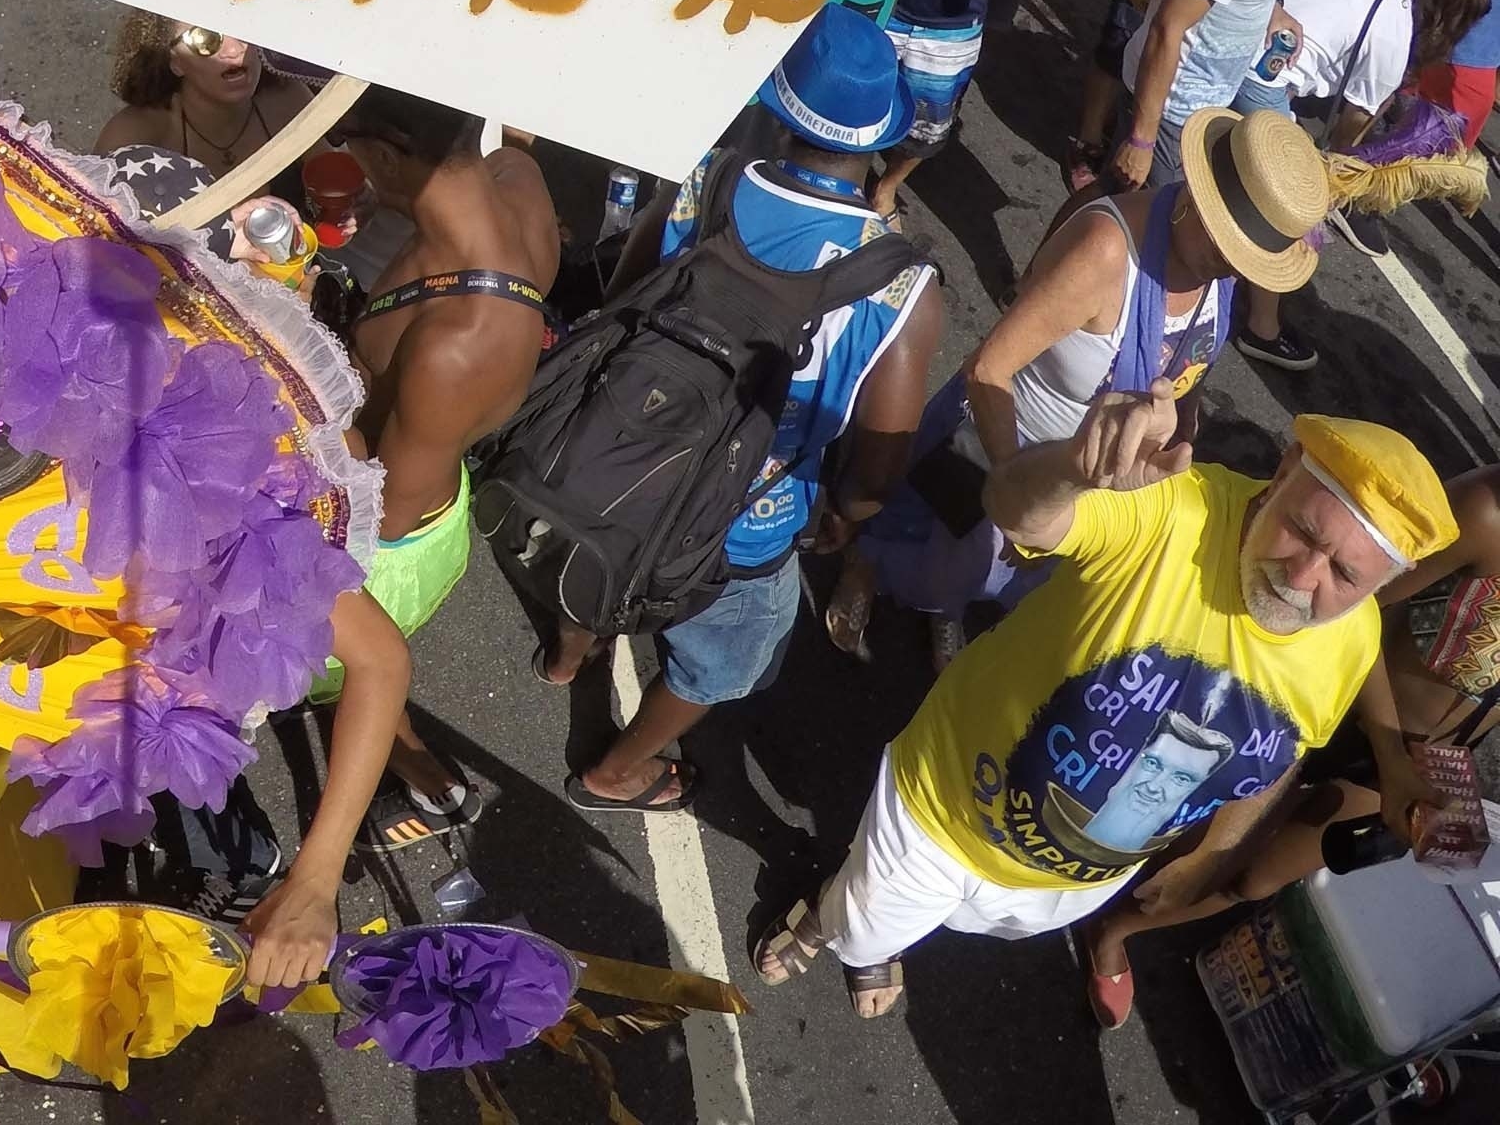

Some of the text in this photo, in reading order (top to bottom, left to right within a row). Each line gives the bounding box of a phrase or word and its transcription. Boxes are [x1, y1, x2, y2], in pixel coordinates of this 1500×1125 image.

[795, 105, 854, 142] DIRETORIA
[424, 276, 460, 289] MAGNA
[467, 280, 499, 289] BOHEMIA
[1119, 654, 1180, 712] SAI
[1084, 683, 1130, 727] CRI
[1046, 724, 1100, 792] CRI
[1088, 730, 1133, 771] CRI
[1239, 728, 1285, 763] DAÍ
